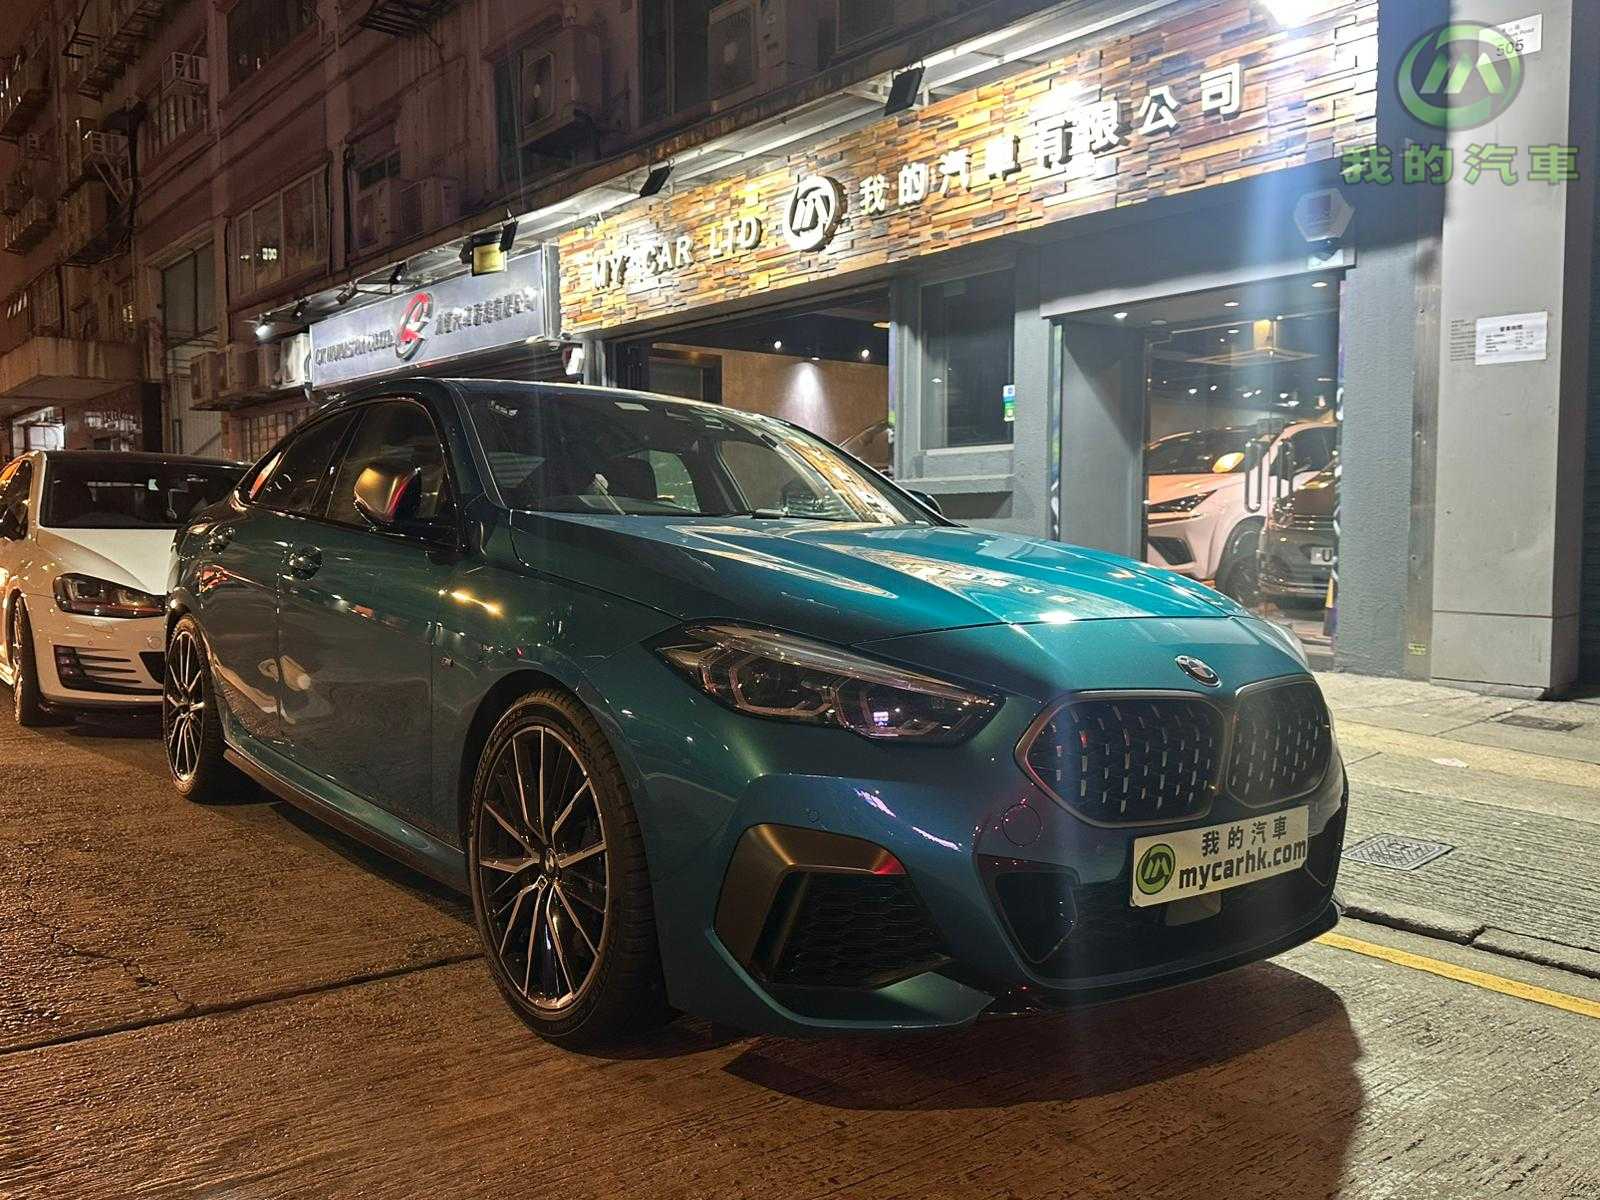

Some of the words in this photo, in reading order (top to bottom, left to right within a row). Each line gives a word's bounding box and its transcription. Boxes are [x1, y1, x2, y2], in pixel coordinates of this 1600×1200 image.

[591, 253, 625, 290] MY
[645, 235, 695, 276] CAR
[710, 216, 762, 260] LTD
[1201, 815, 1288, 858] 我的汽車
[1178, 838, 1307, 891] mycarhk.com
